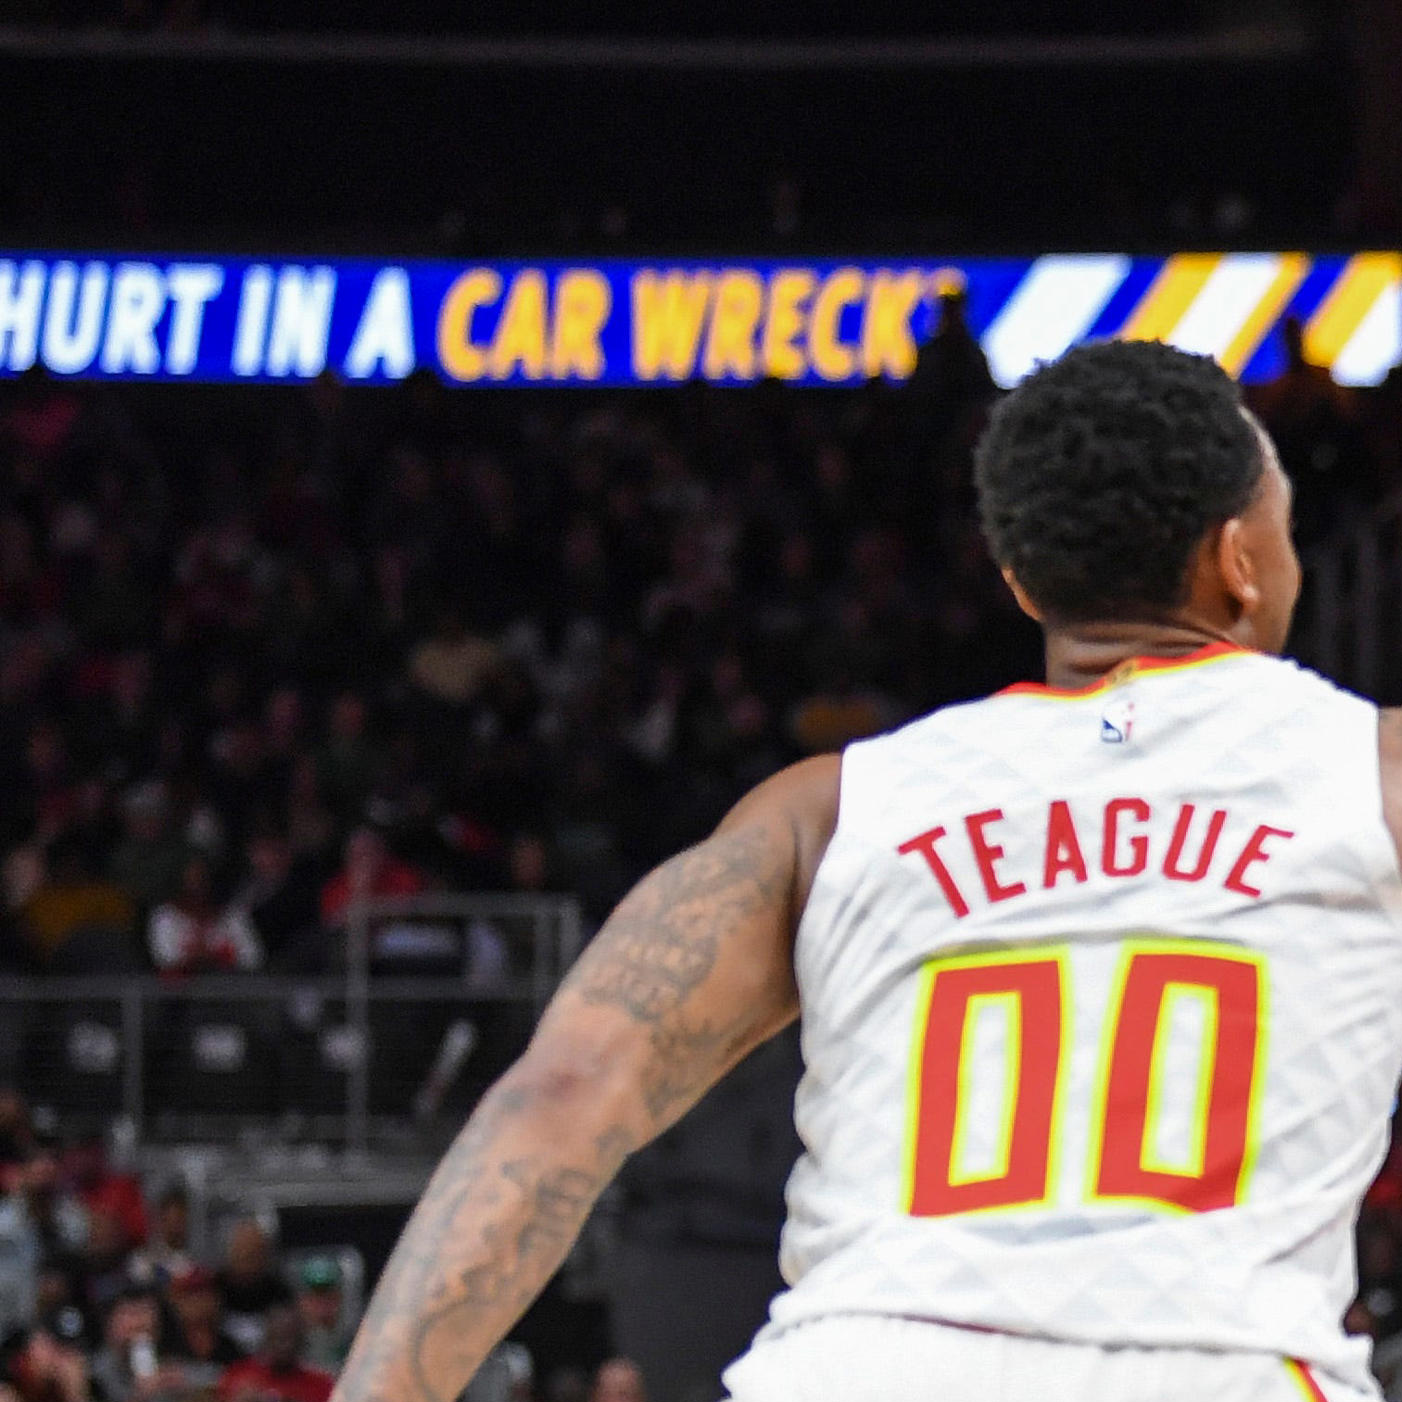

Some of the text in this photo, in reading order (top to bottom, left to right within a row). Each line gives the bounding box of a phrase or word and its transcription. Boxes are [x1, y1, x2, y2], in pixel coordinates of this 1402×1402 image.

[0, 258, 224, 375] HURT
[230, 263, 338, 377] IN
[342, 266, 416, 379] A
[437, 268, 611, 381] CAR
[898, 798, 1294, 919] TEAGUE
[899, 937, 1267, 1218] 00
